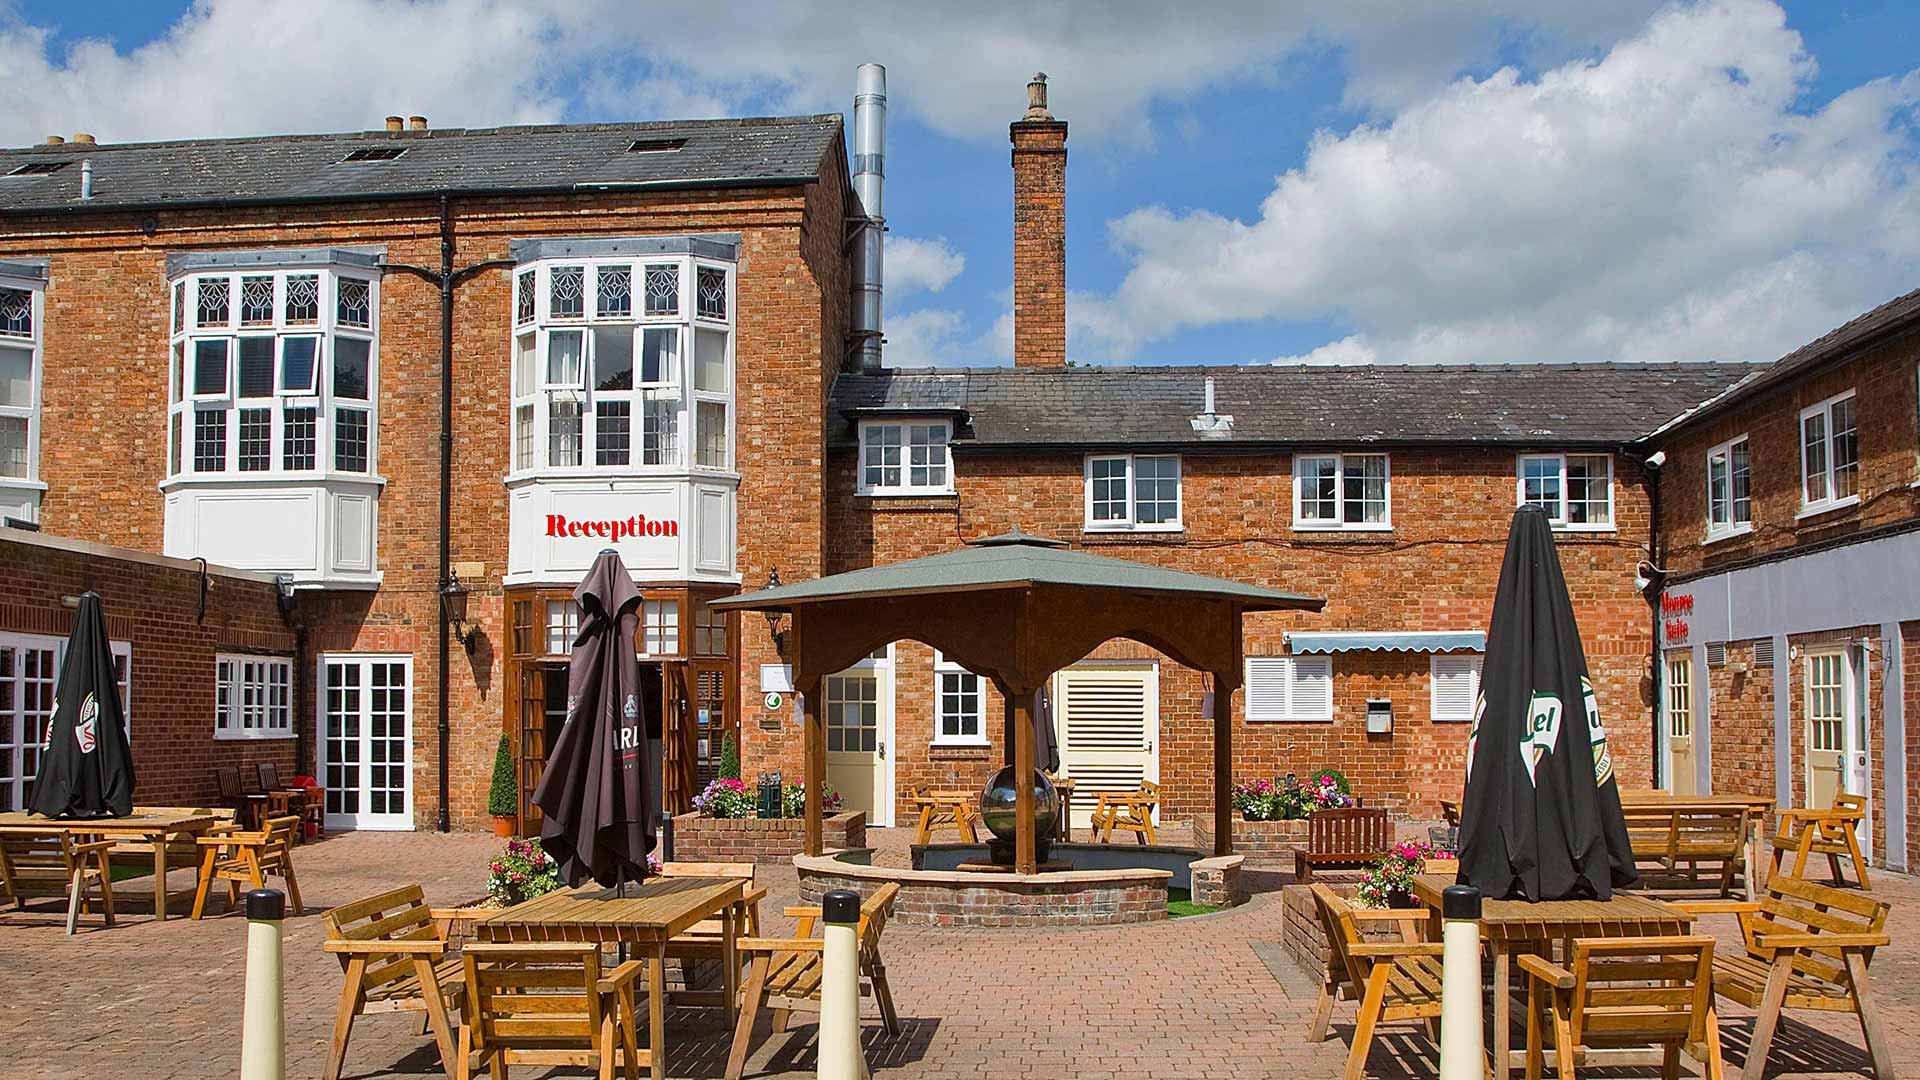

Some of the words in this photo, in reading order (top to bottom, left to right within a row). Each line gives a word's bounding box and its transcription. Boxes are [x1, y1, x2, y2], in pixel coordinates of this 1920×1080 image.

[545, 513, 679, 543] Reception
[1661, 591, 1694, 612] Monroe
[1666, 618, 1688, 640] Suite
